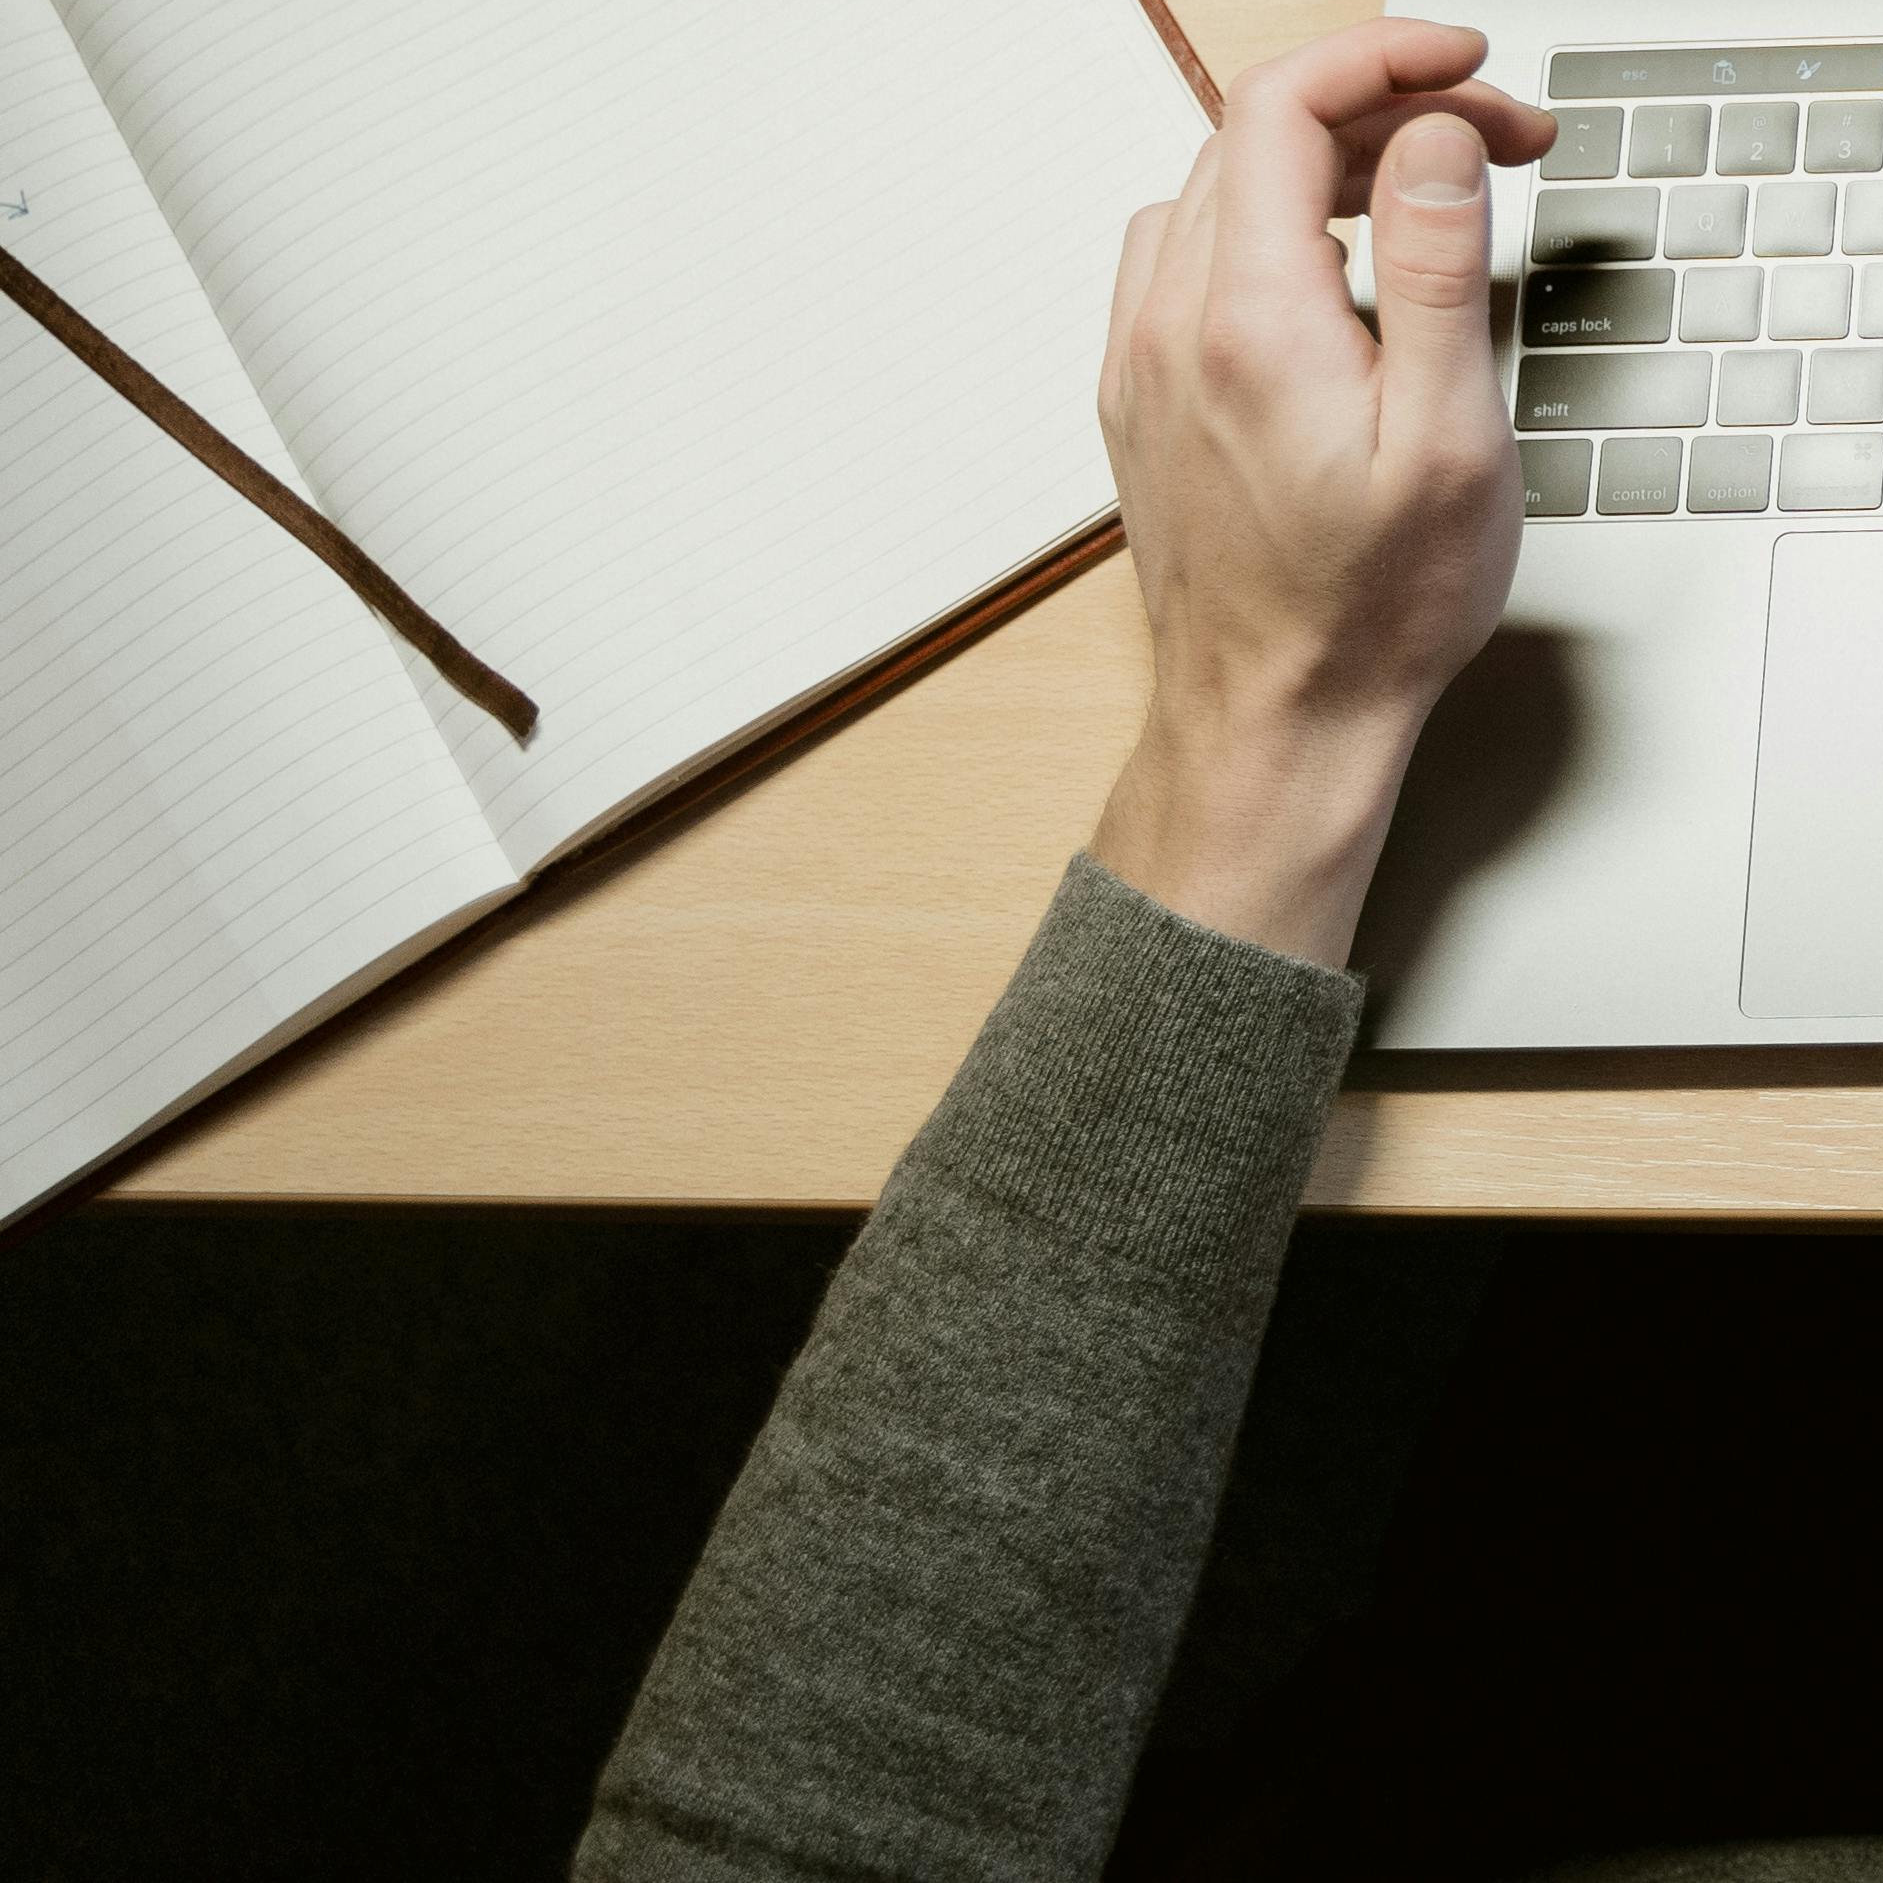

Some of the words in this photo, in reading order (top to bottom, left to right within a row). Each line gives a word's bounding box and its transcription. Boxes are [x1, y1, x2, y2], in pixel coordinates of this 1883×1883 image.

[1621, 67, 1649, 82] esc
[1663, 144, 1674, 164] 1
[1749, 142, 1765, 162] 2
[1837, 139, 1853, 160] 3
[1698, 213, 1715, 232] Q
[1548, 234, 1575, 250] tab
[1541, 319, 1577, 335] caps
[1580, 318, 1612, 334] lock
[1533, 403, 1569, 418] shift
[1525, 489, 1541, 504] fn
[1612, 485, 1667, 502] control
[1707, 484, 1758, 504] option
